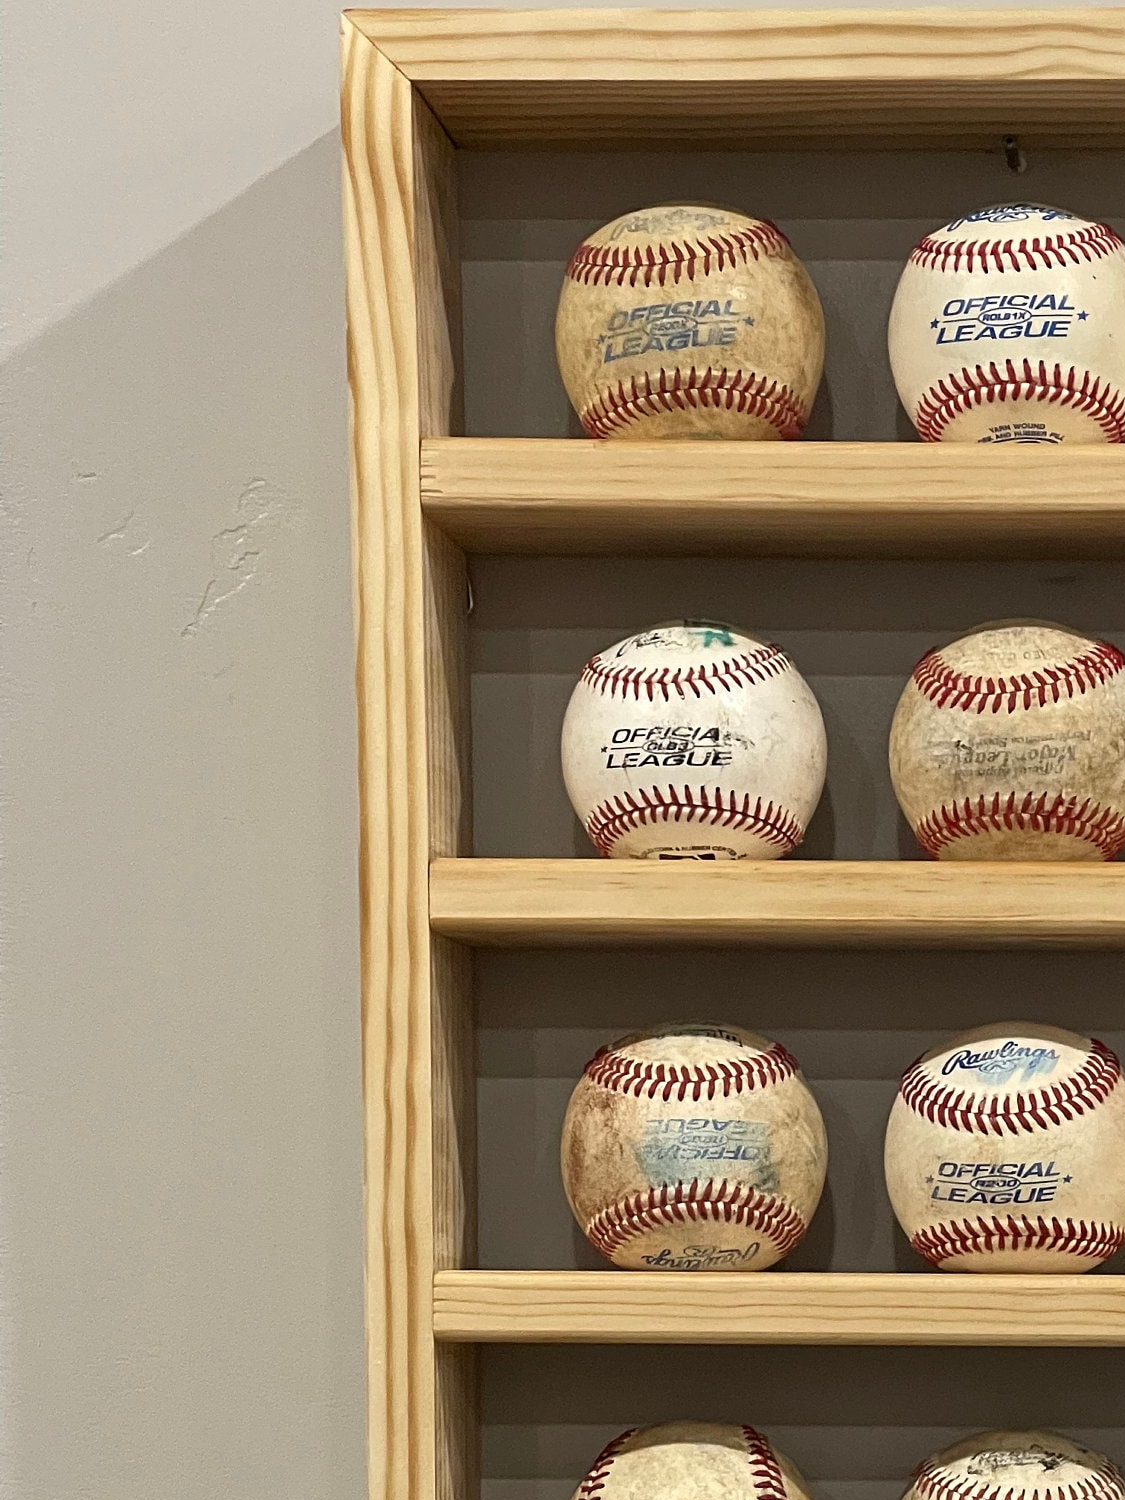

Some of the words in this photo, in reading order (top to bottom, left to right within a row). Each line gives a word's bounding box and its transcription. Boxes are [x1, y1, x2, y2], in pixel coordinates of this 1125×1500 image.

[607, 300, 741, 331] OFFICIAL
[942, 294, 1075, 317] OFFICIAL
[936, 321, 1071, 344] LEAGUE
[604, 327, 738, 363] LEAGUE
[606, 751, 733, 768] LEAGUE
[942, 1041, 1061, 1075] Rawlings
[938, 1162, 1060, 1178] OFFICIAL
[931, 1186, 1057, 1204] LEAGUE
